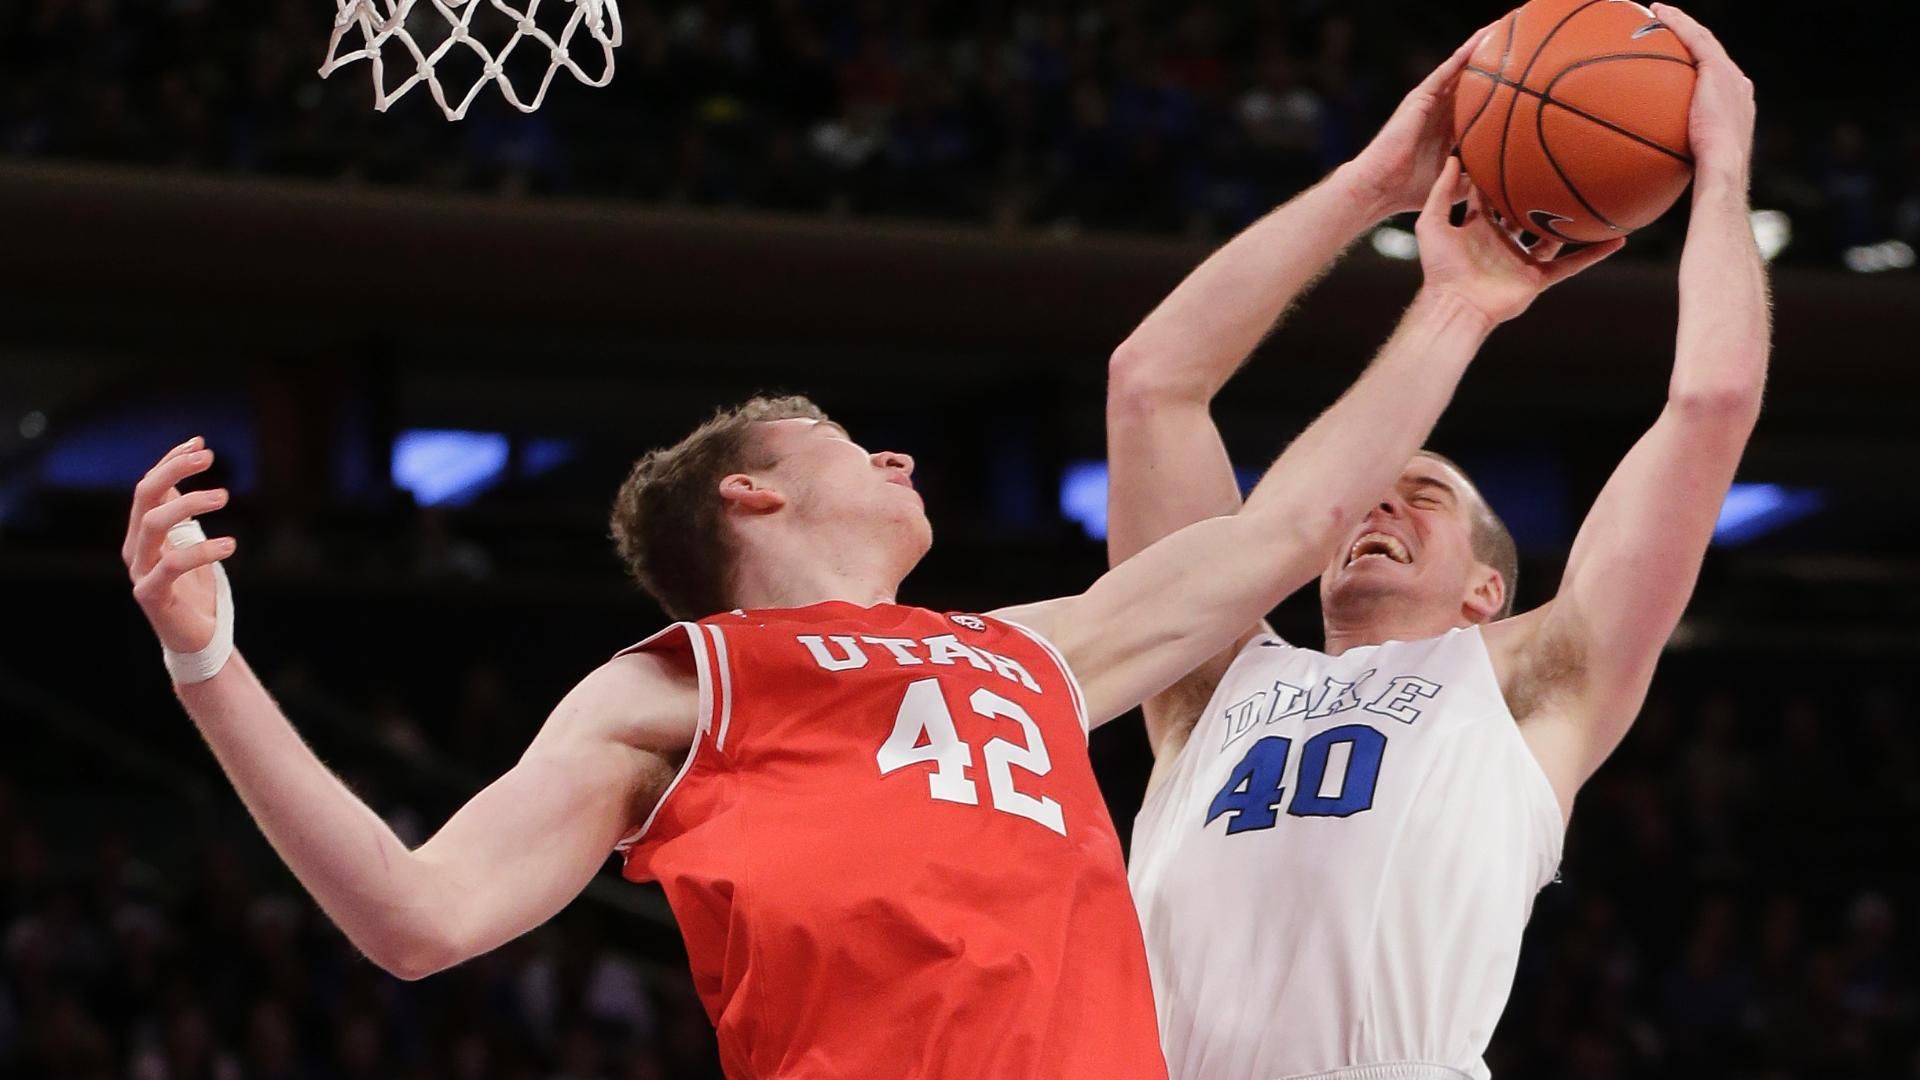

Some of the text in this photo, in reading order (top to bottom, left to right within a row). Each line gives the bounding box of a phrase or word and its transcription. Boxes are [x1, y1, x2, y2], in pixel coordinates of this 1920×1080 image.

[797, 634, 1043, 694] UTAH
[876, 676, 1068, 837] 42
[1203, 724, 1388, 836] 40
